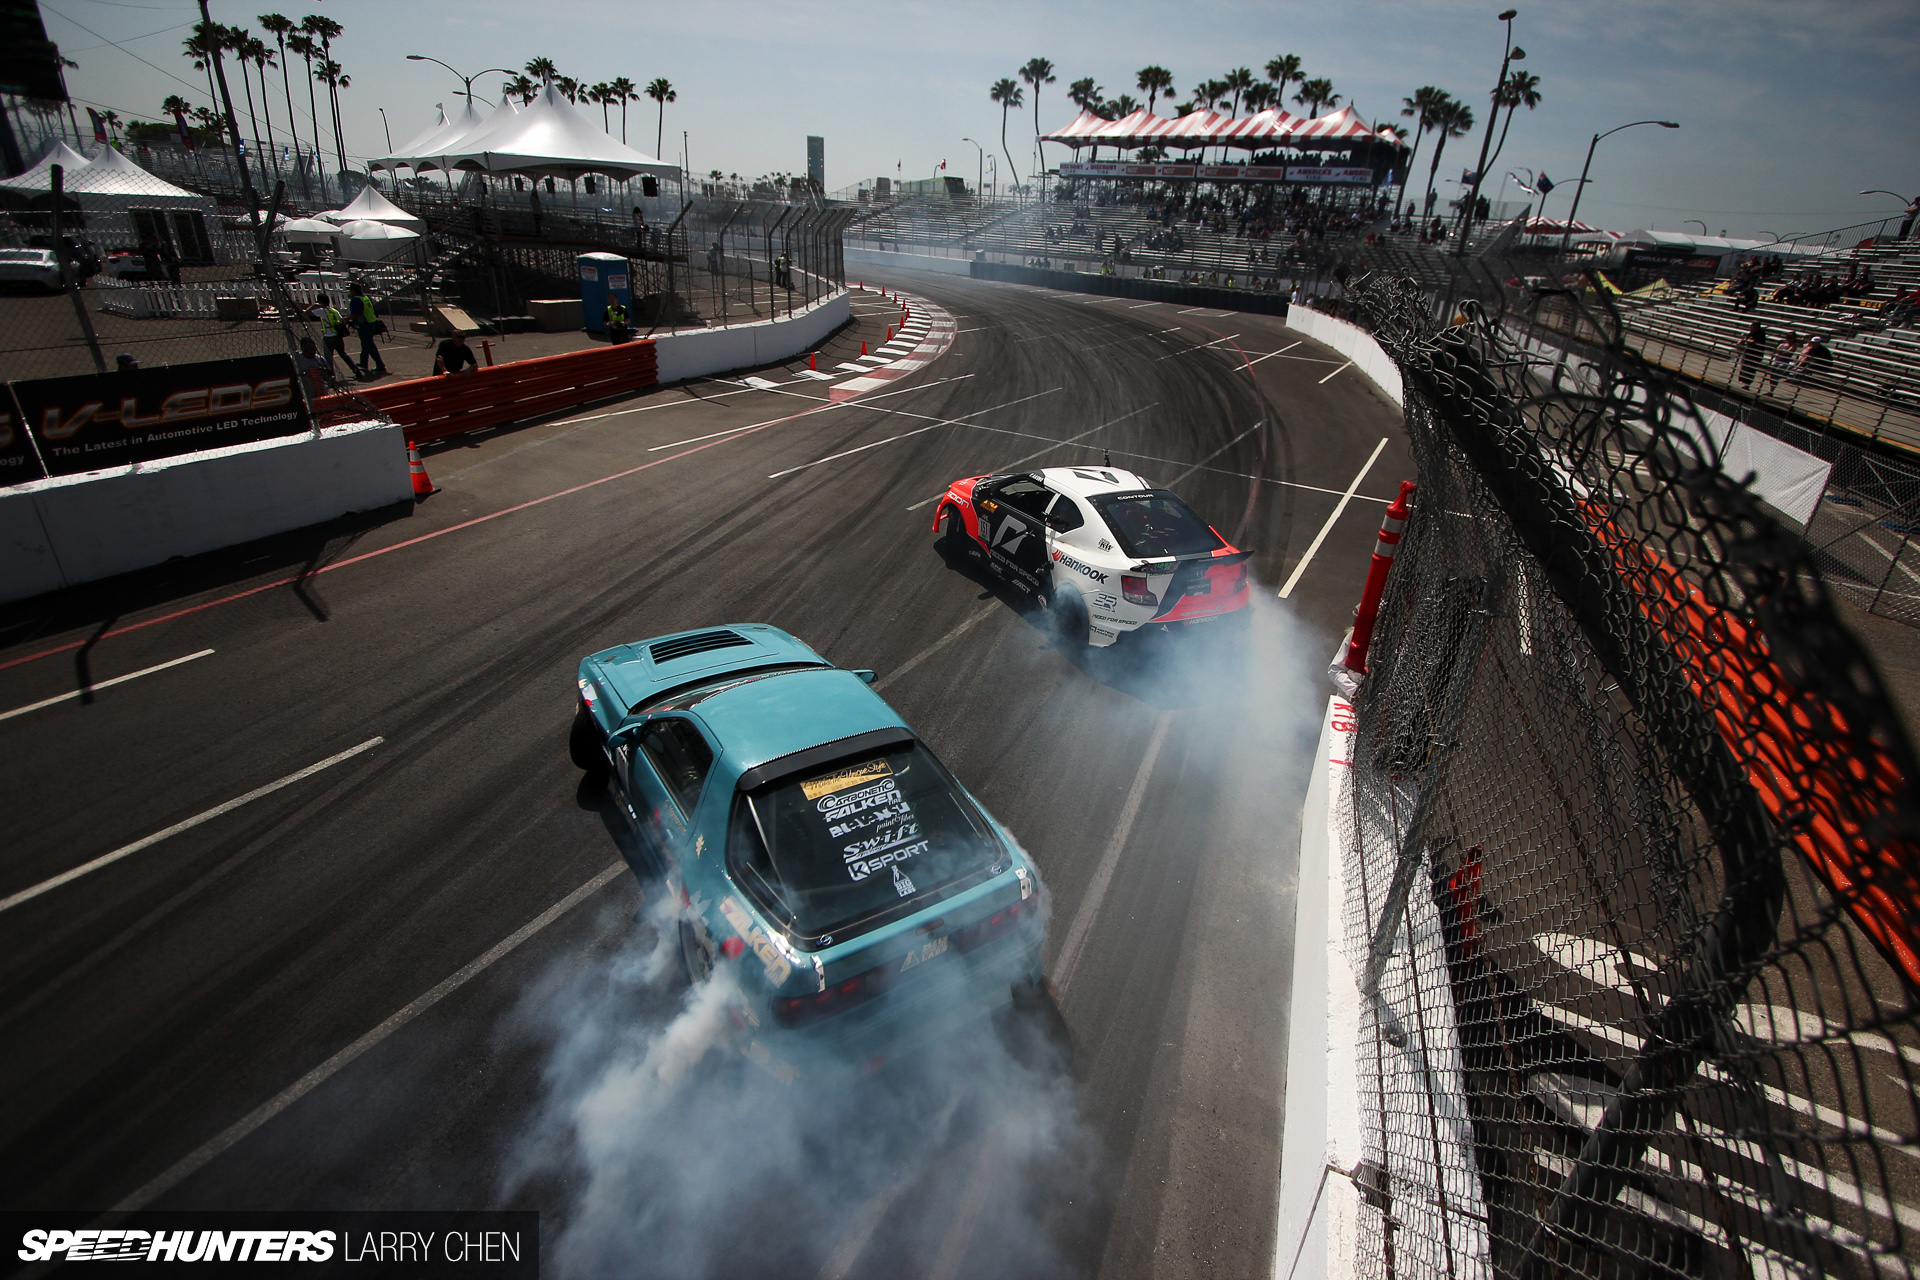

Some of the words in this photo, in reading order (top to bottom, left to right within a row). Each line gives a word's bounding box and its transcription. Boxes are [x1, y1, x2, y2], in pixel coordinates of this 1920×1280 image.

[42, 378, 293, 440] V-LEDS
[52, 447, 81, 457] The
[84, 440, 128, 453] Latest
[131, 436, 143, 445] in
[147, 425, 214, 442] Automotive
[216, 420, 239, 431] LED
[241, 411, 299, 428] Technology
[823, 790, 901, 823] FALKEN
